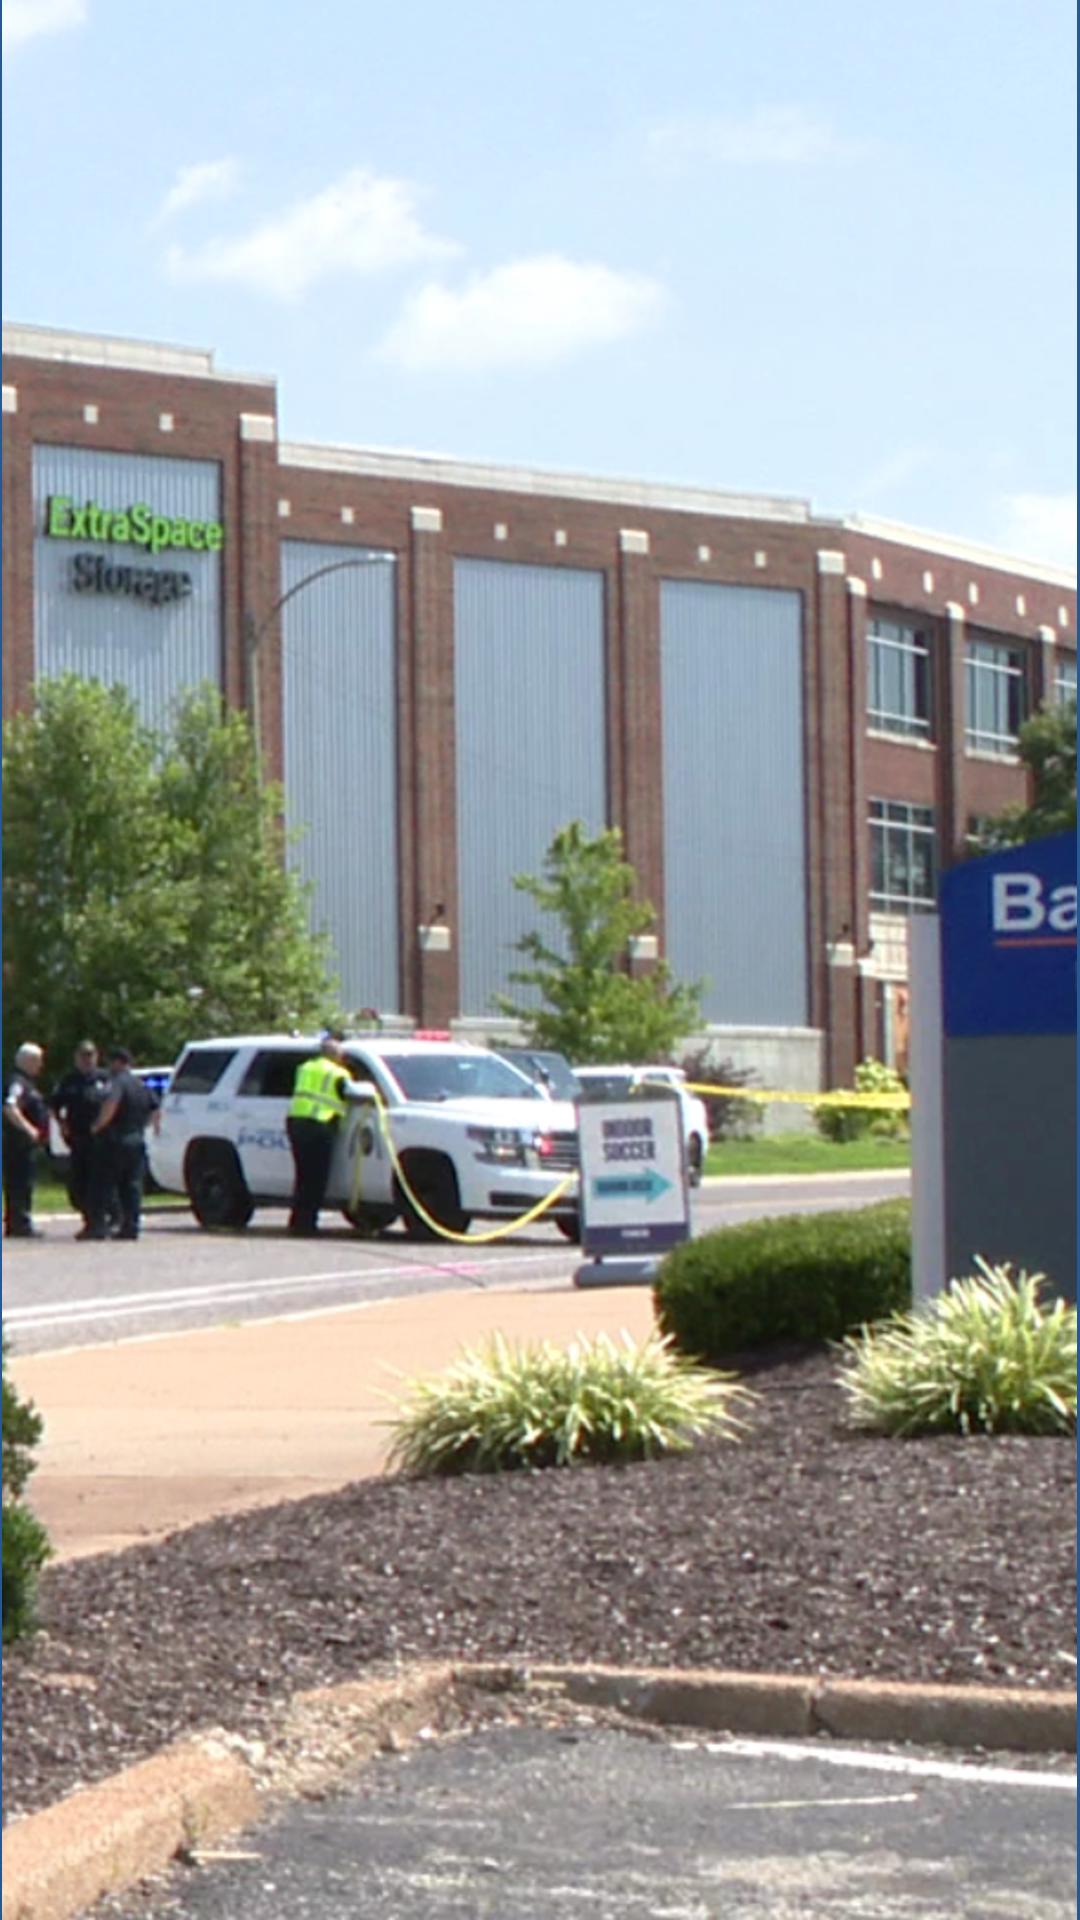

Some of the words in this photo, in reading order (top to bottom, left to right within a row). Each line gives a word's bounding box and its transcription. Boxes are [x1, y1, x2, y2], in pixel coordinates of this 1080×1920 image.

[47, 495, 224, 554] ExtraSpace
[72, 552, 192, 604] Storage
[992, 871, 1077, 932] Ba
[602, 1118, 653, 1138] INDOOR
[604, 1140, 656, 1162] SOCCER
